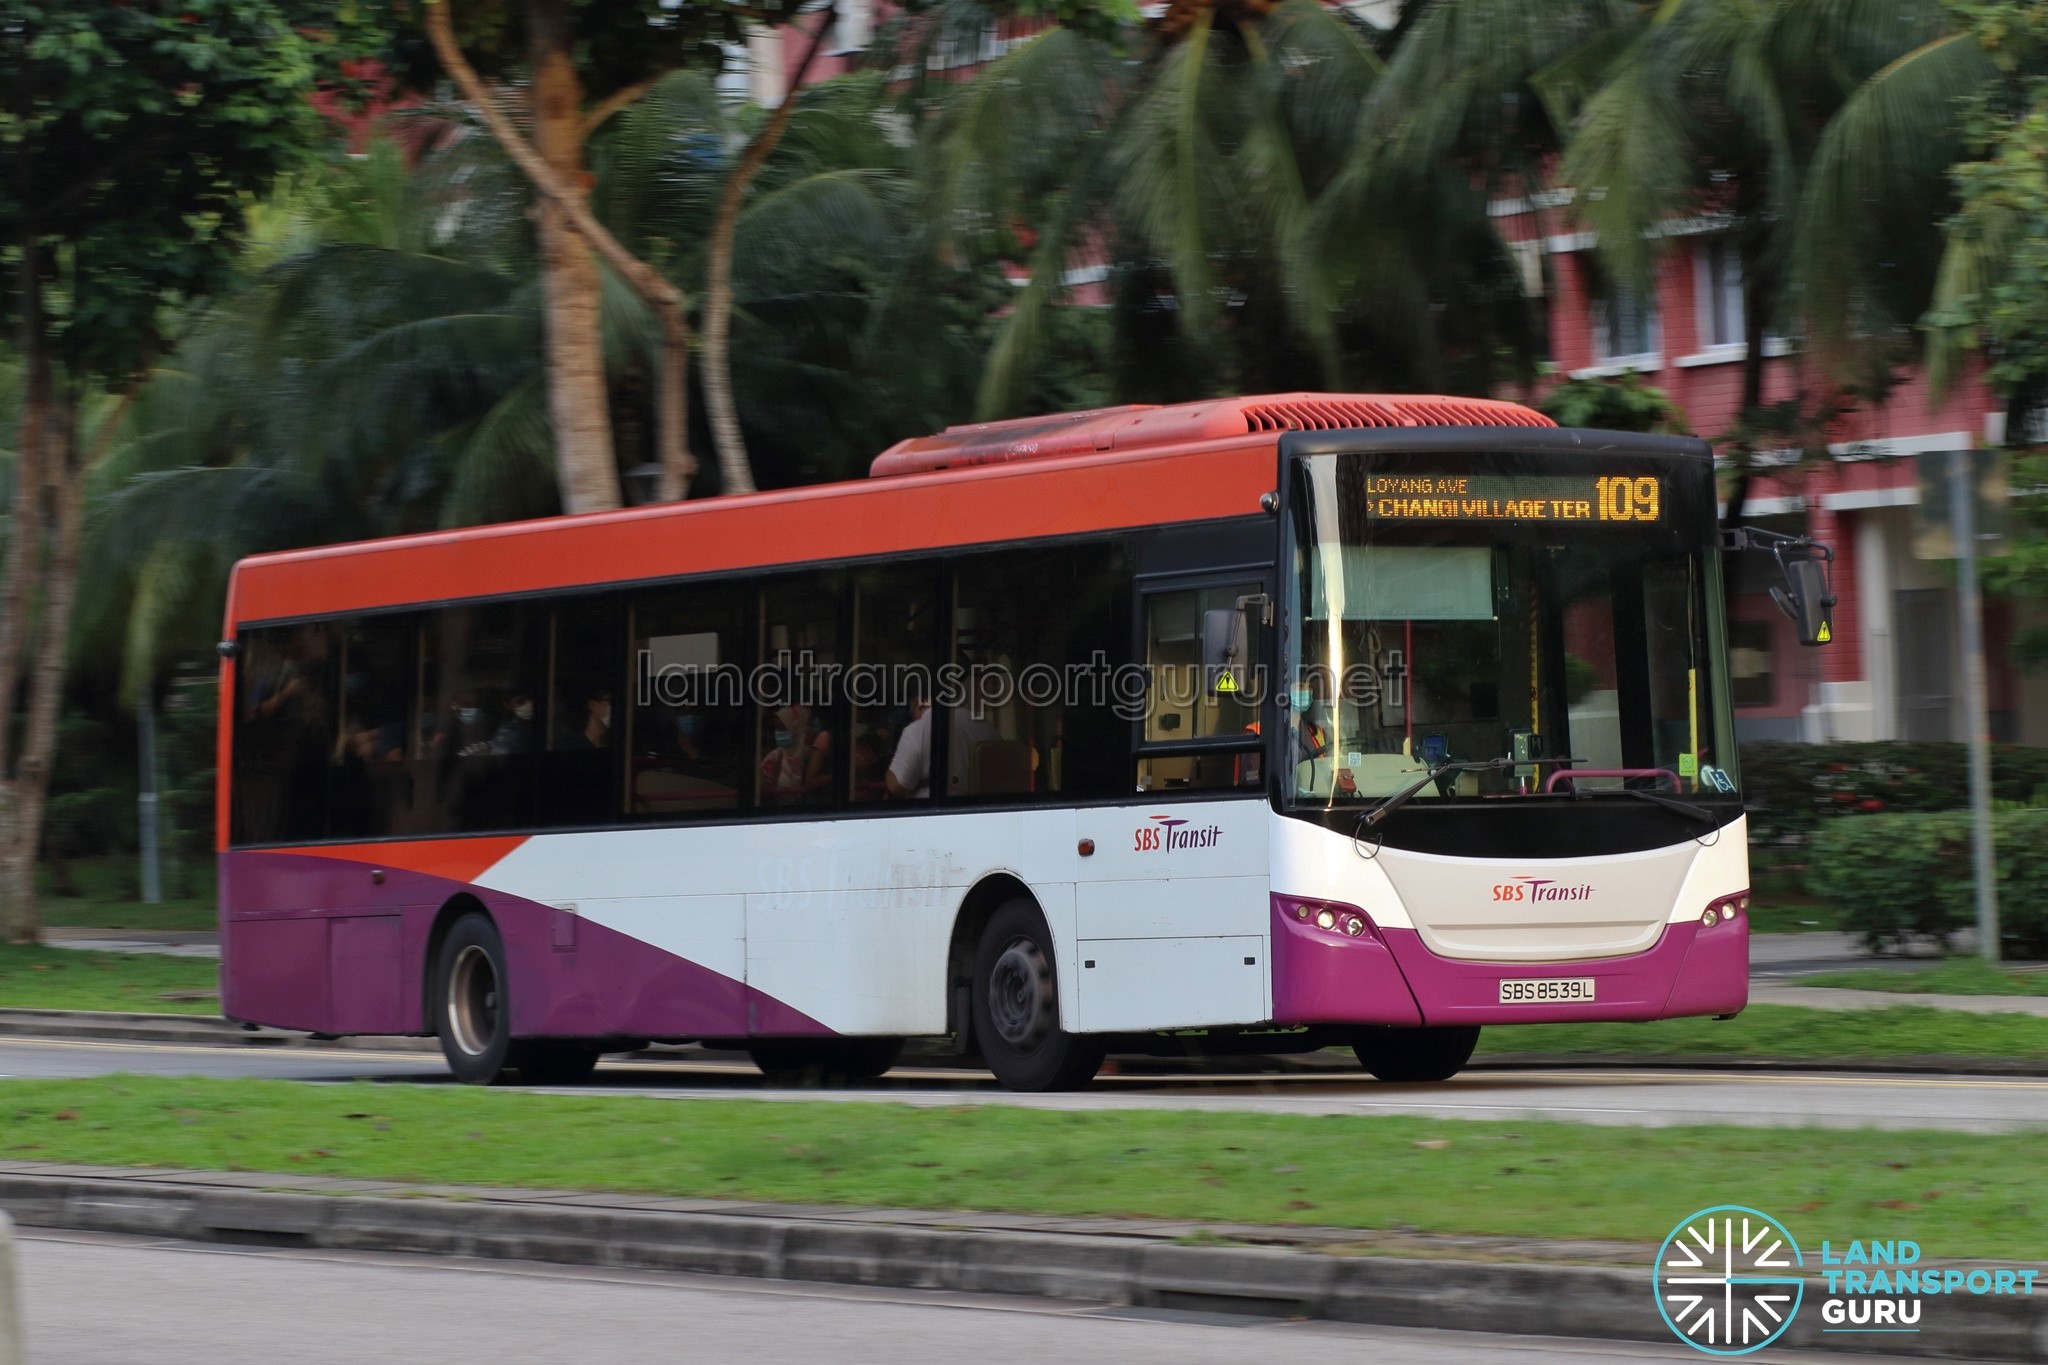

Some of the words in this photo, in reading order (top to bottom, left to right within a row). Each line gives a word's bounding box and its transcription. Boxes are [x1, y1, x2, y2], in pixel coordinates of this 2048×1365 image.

[1367, 478, 1432, 494] LOYANG
[1436, 478, 1468, 494] AVE
[1595, 476, 1659, 521] 109
[1378, 499, 1458, 517] CHANGI
[1462, 499, 1546, 518] VILLAGE
[1549, 501, 1590, 518] TER
[1134, 827, 1160, 851] SBS
[1158, 819, 1224, 854] Transit
[1493, 885, 1524, 901] SBS
[1523, 880, 1596, 905] Transit
